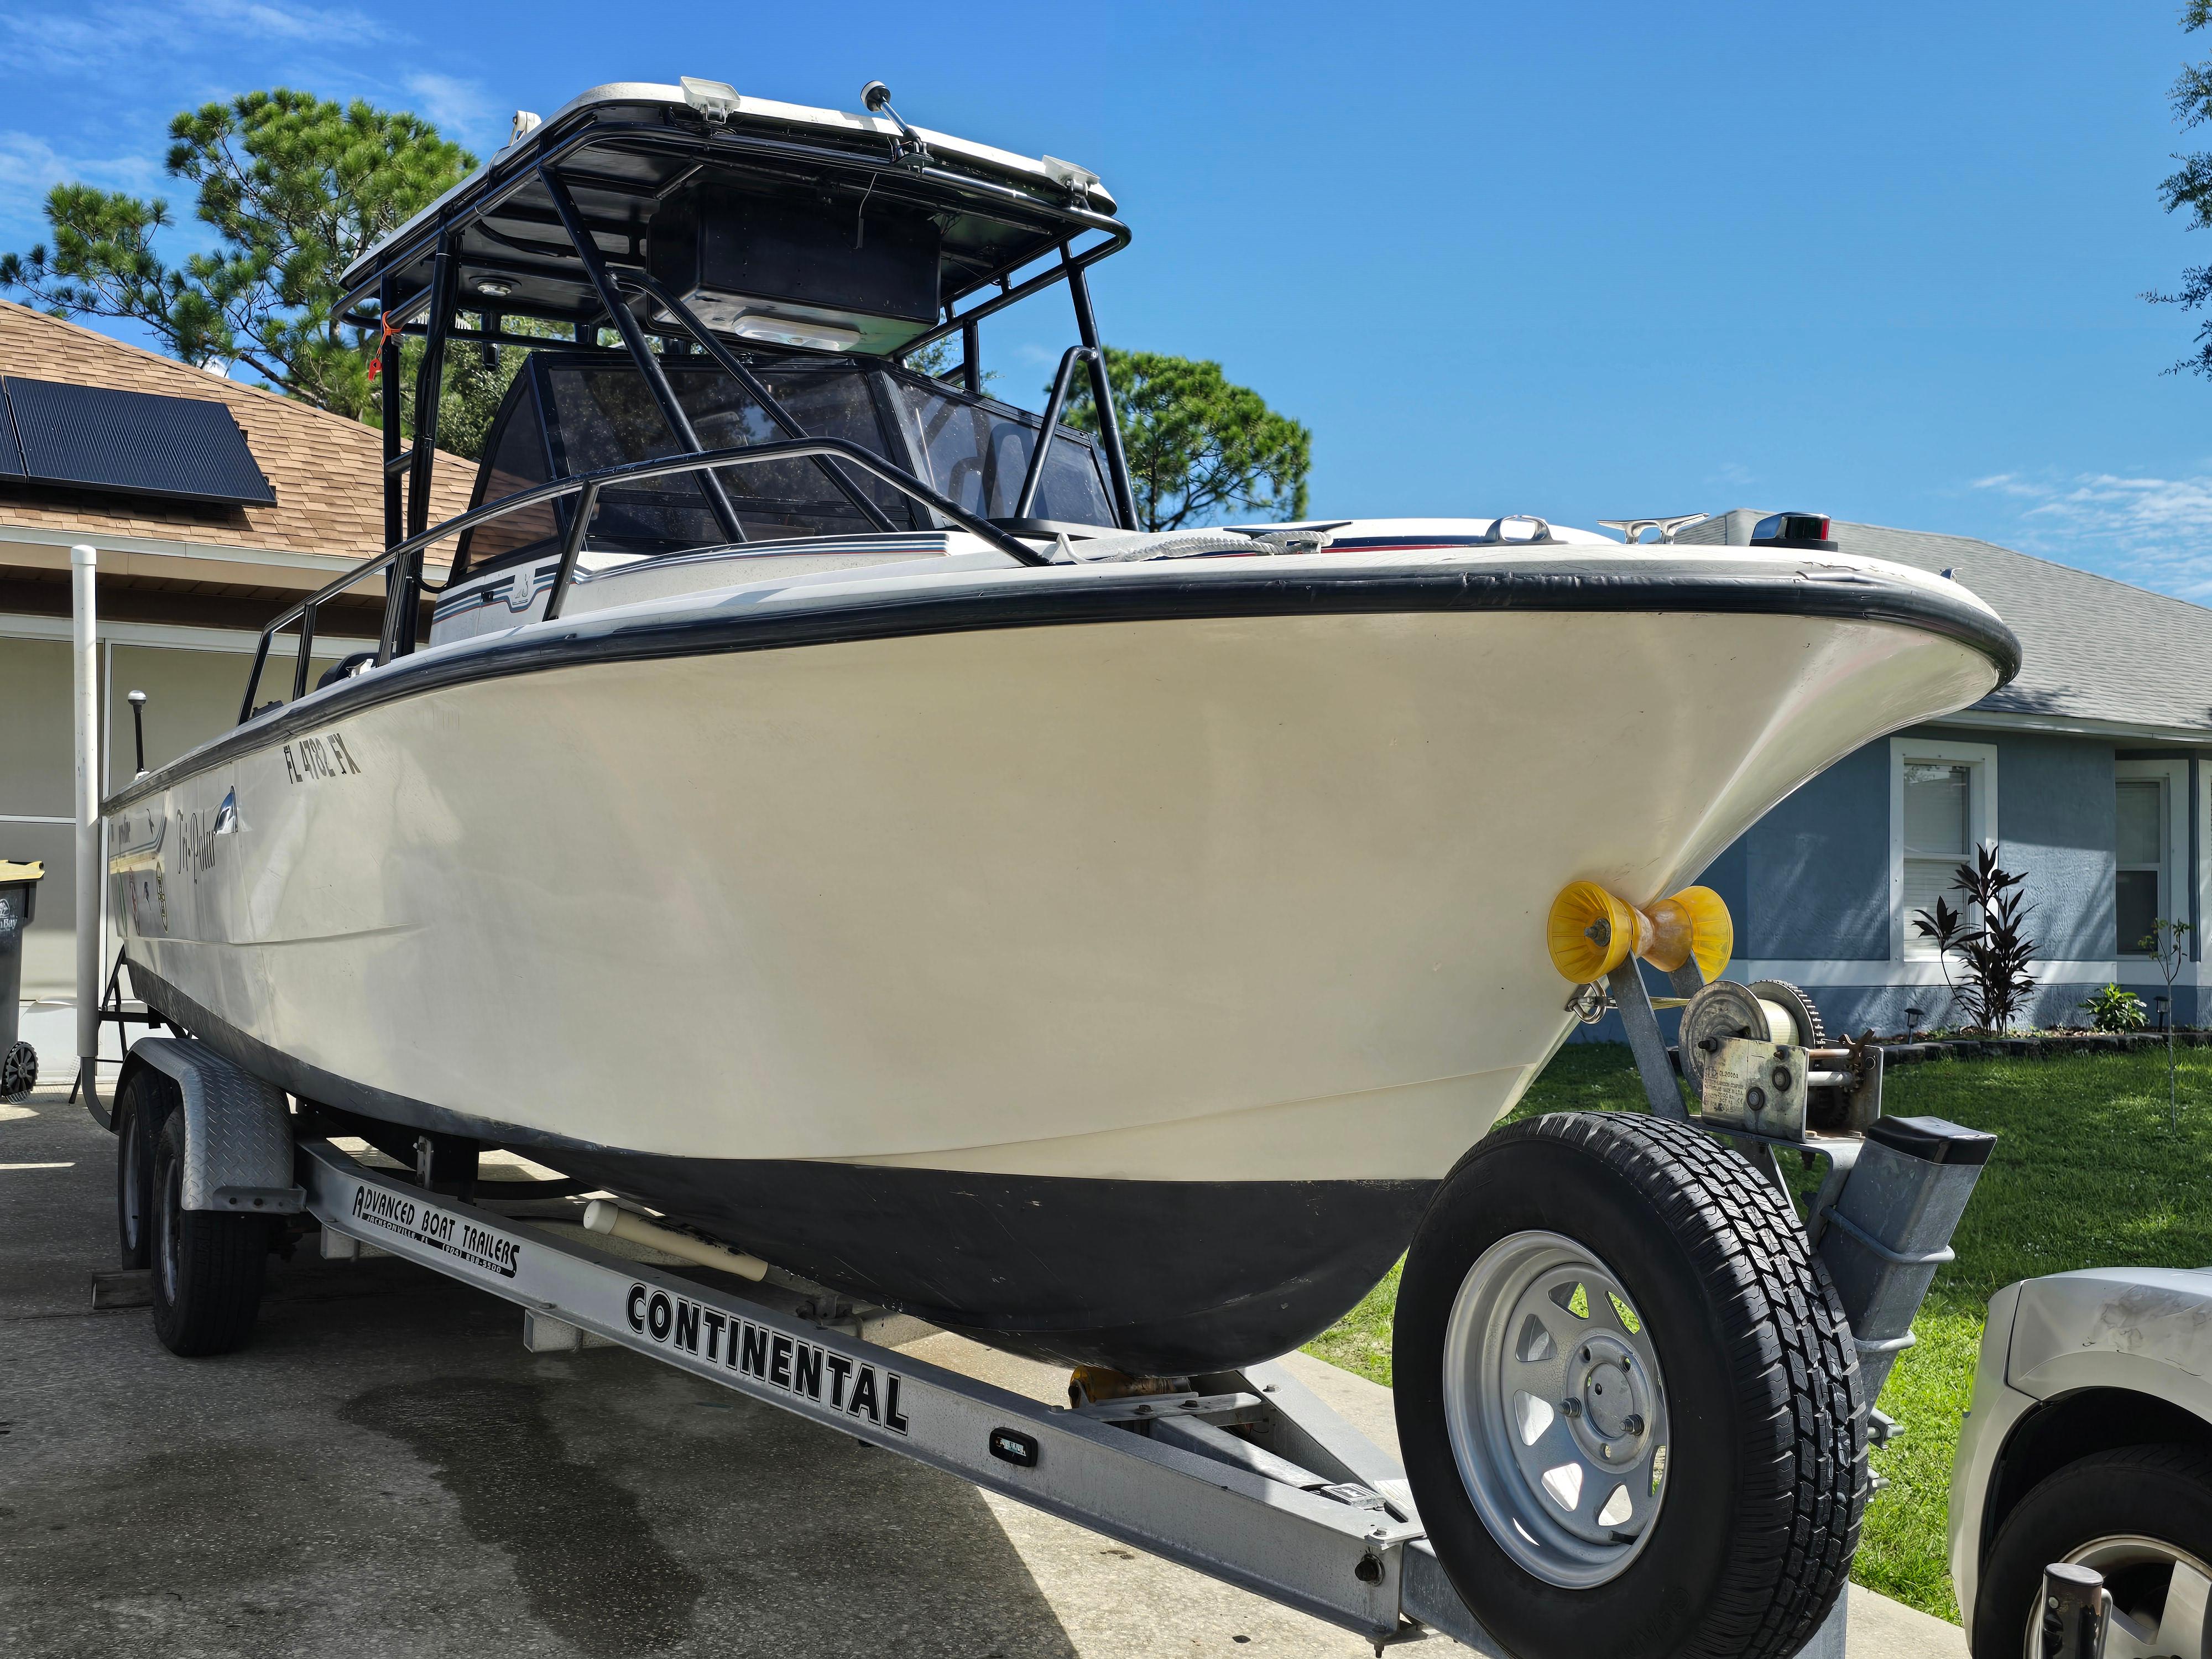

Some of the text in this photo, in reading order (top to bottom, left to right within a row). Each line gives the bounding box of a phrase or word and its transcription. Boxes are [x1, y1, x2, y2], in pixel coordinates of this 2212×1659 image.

[283, 733, 361, 784] FL 4782 FX
[352, 1185, 520, 1275] ADVANCED BOAT TRAILERS
[421, 1236, 429, 1244] FL
[625, 1282, 909, 1436] CONTINENTAL
